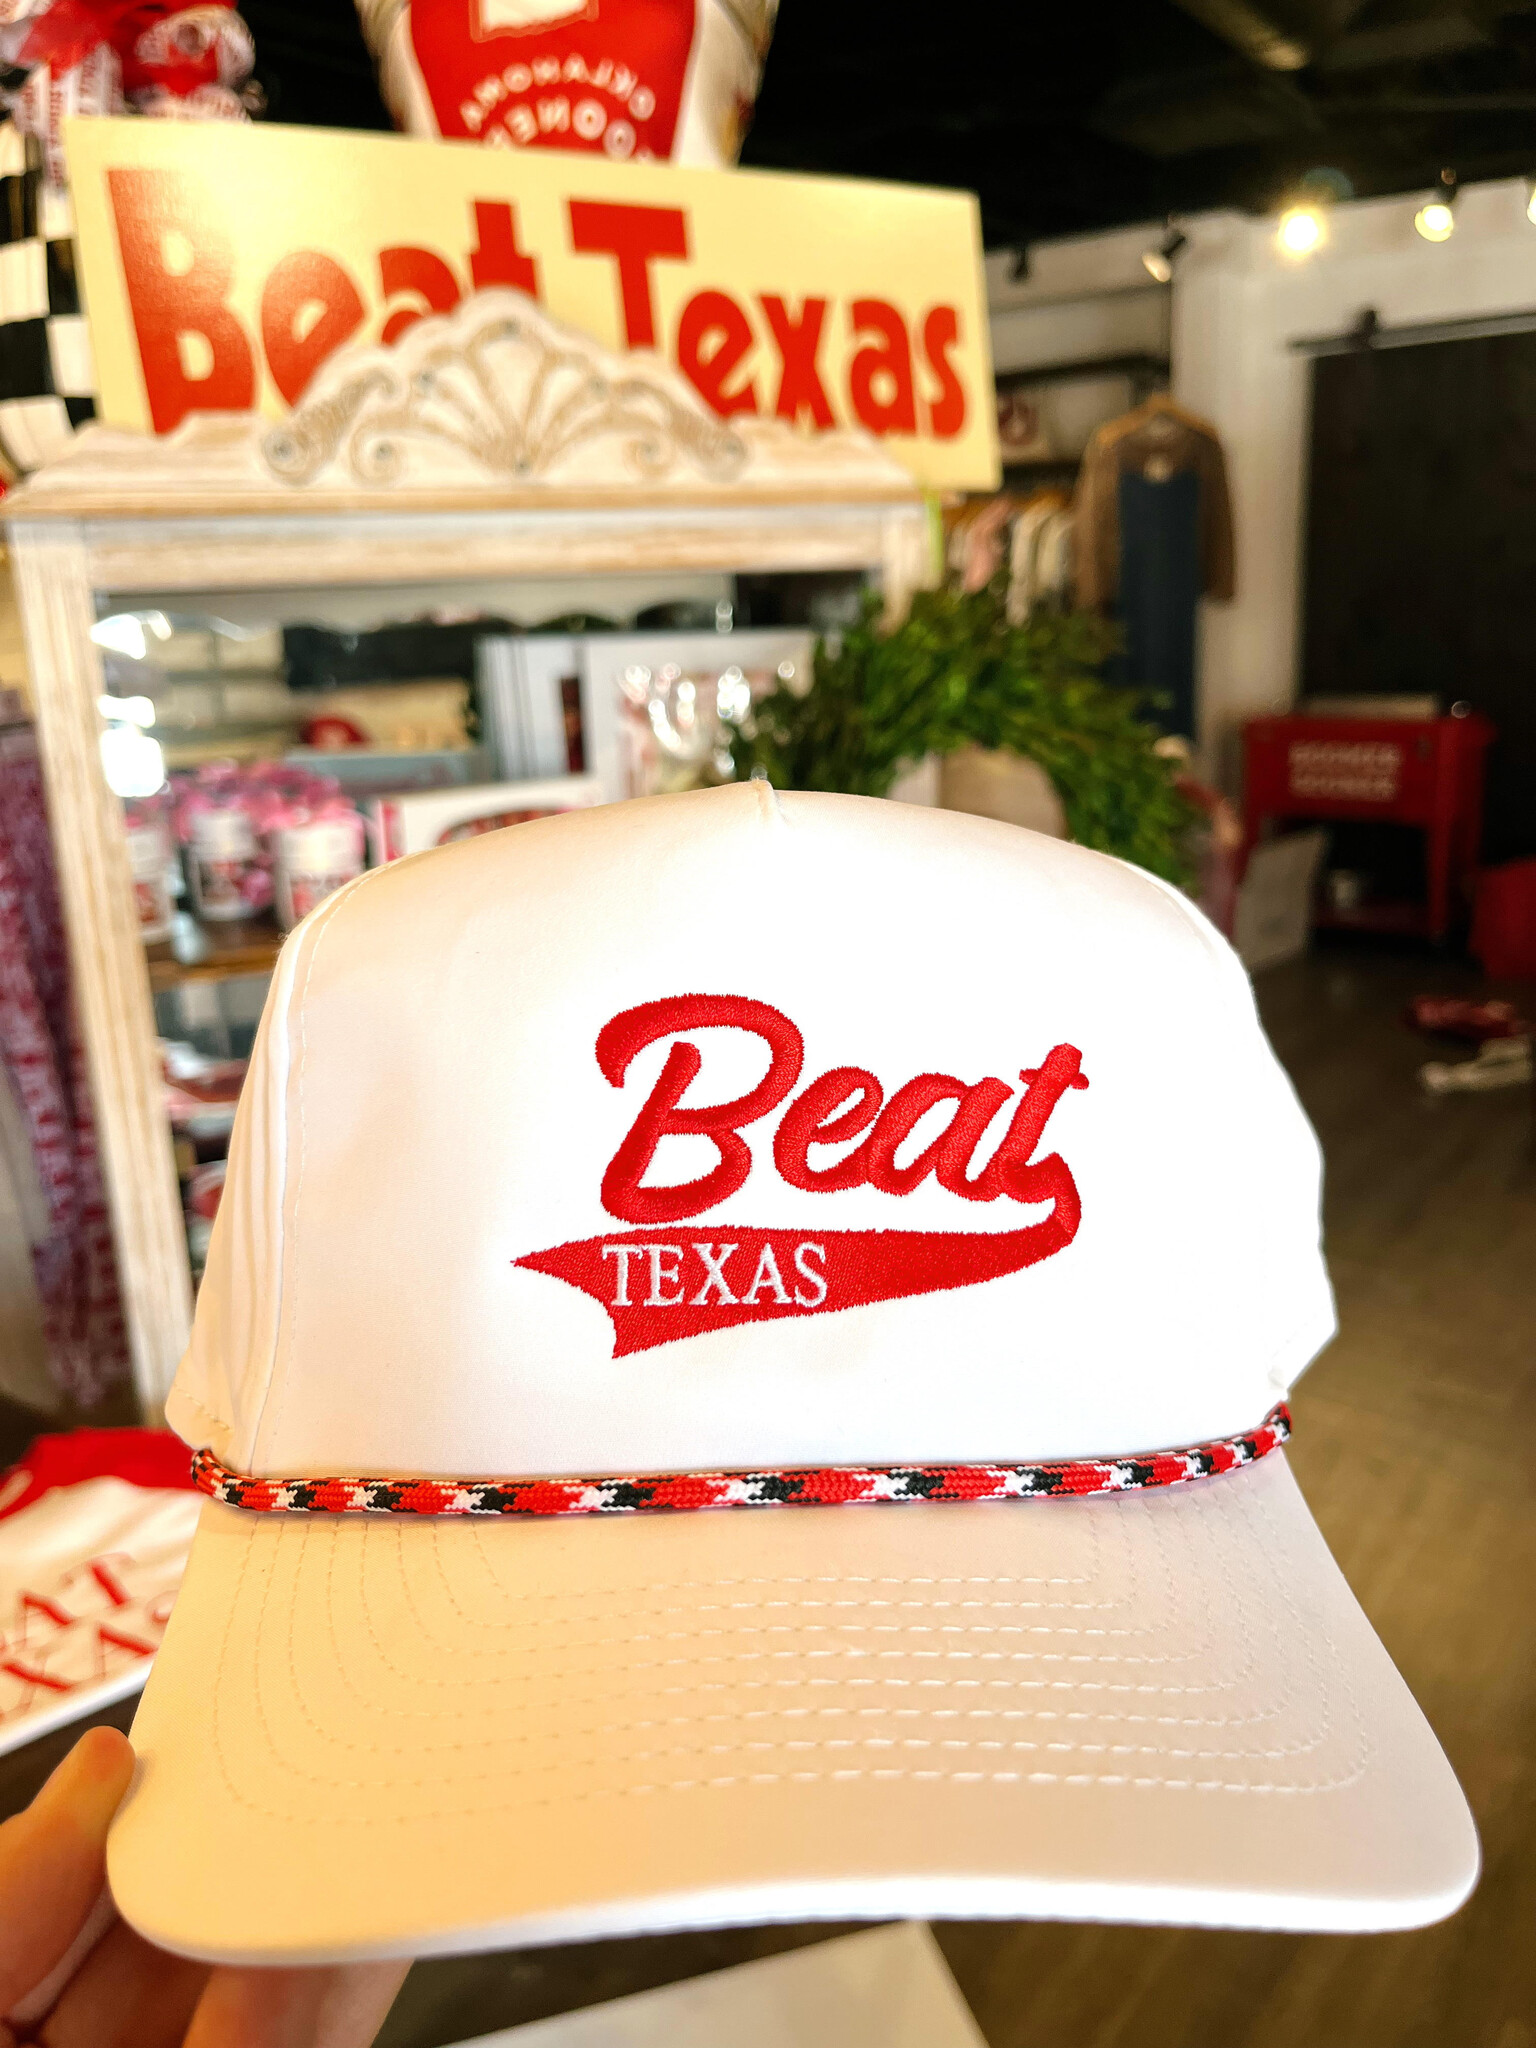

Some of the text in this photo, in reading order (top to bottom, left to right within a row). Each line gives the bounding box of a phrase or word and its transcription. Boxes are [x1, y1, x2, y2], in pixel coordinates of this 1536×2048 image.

[568, 197, 967, 440] Texas
[594, 992, 1090, 1225] Beat
[601, 1241, 828, 1308] TEXAS
